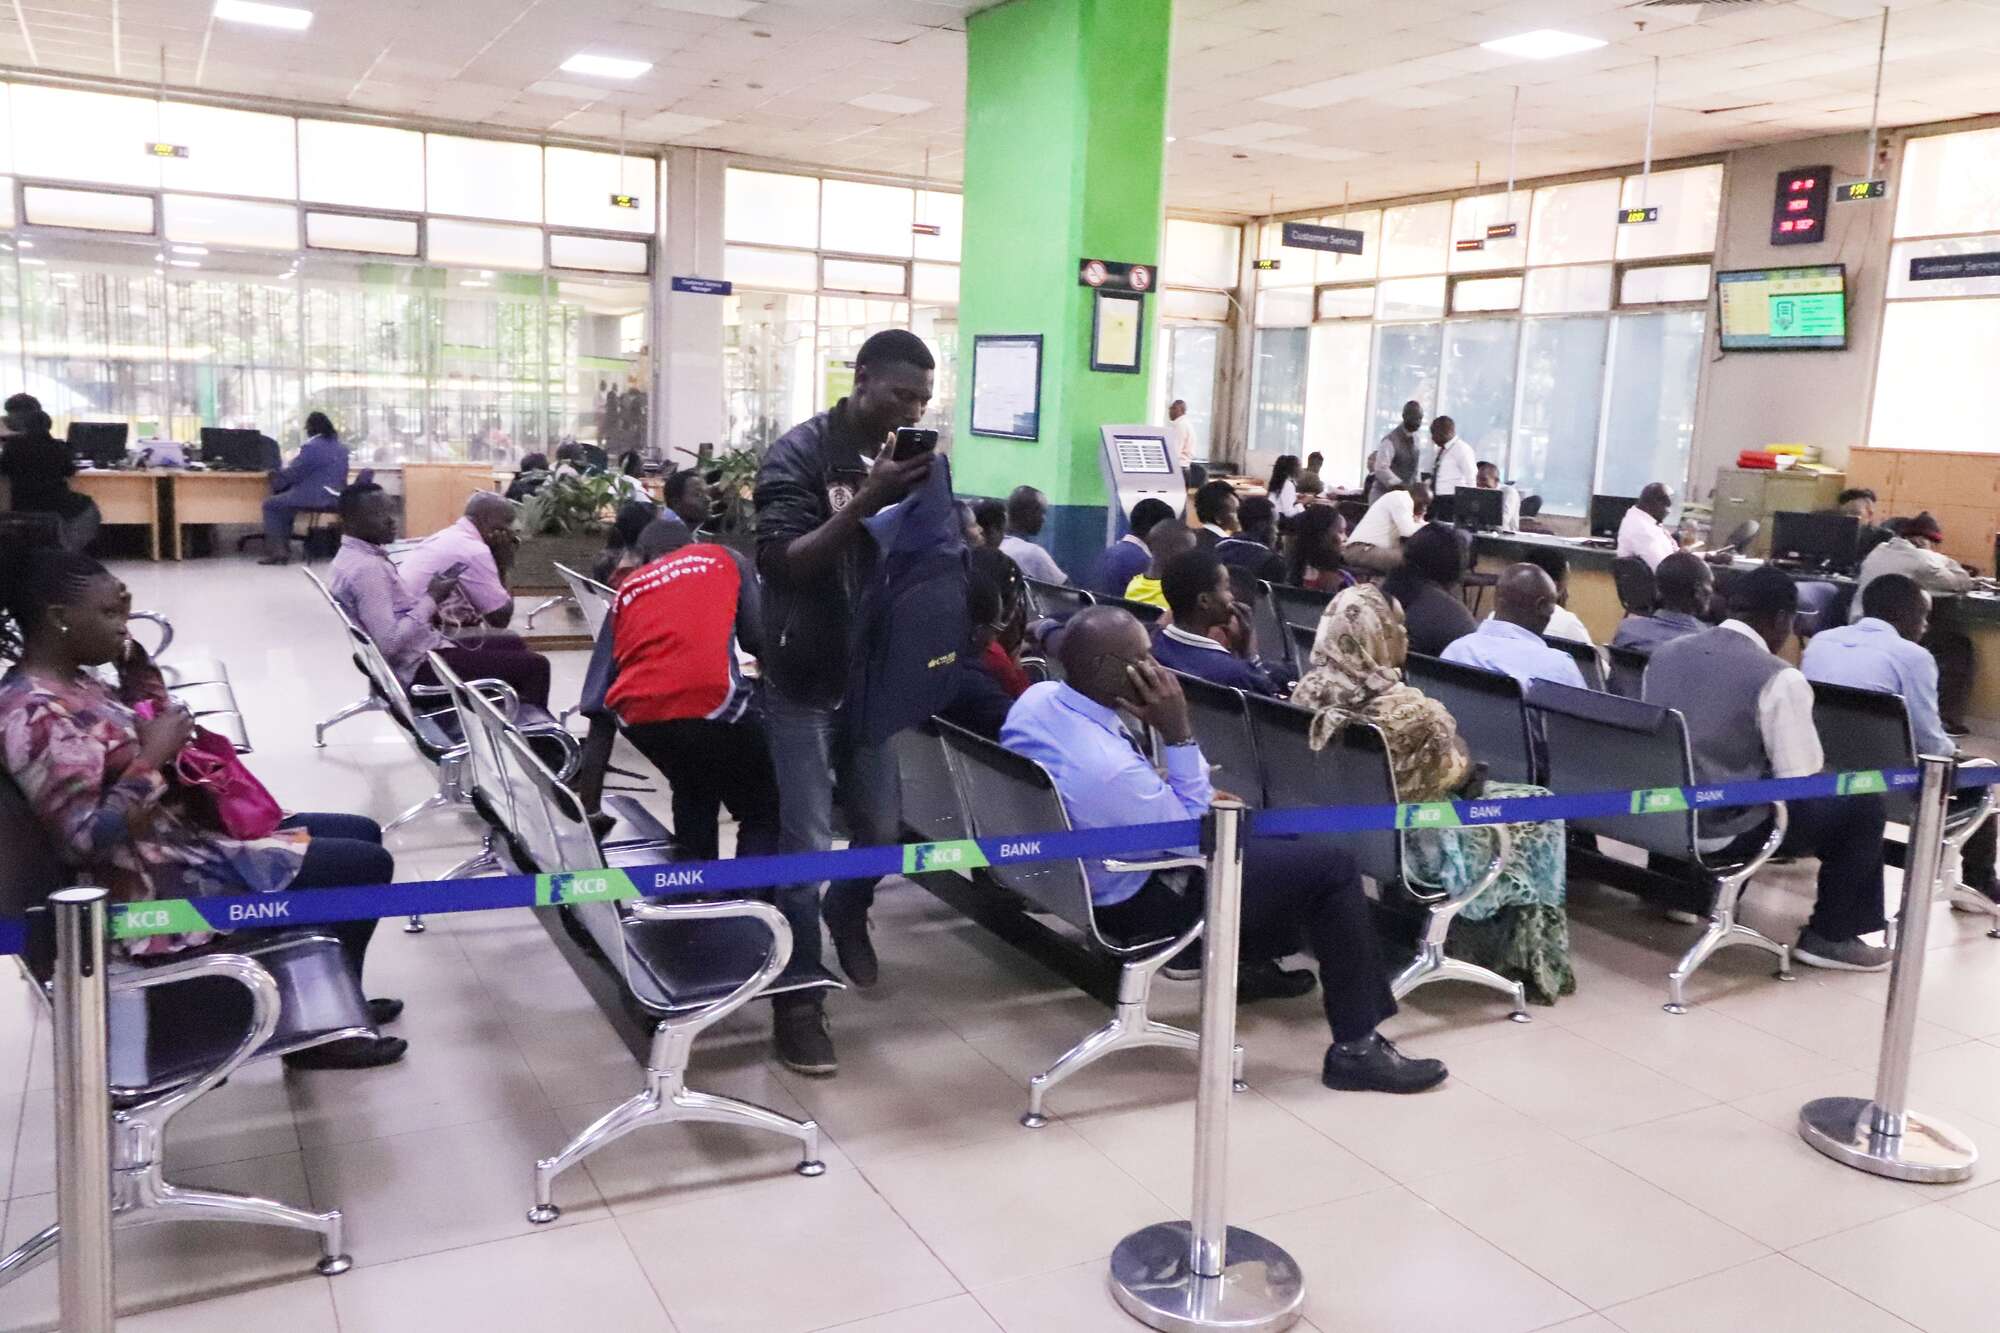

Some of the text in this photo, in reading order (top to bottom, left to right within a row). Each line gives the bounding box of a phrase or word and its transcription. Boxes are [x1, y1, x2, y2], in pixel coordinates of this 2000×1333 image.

[1292, 229, 1358, 247] Customer Service
[1918, 263, 1963, 275] Customer
[1696, 790, 1724, 802] BANK
[1470, 805, 1502, 819] BANK
[932, 841, 1041, 864] KCB BANK
[572, 870, 704, 896] KCB BANK
[127, 901, 289, 929] KCB BANK
